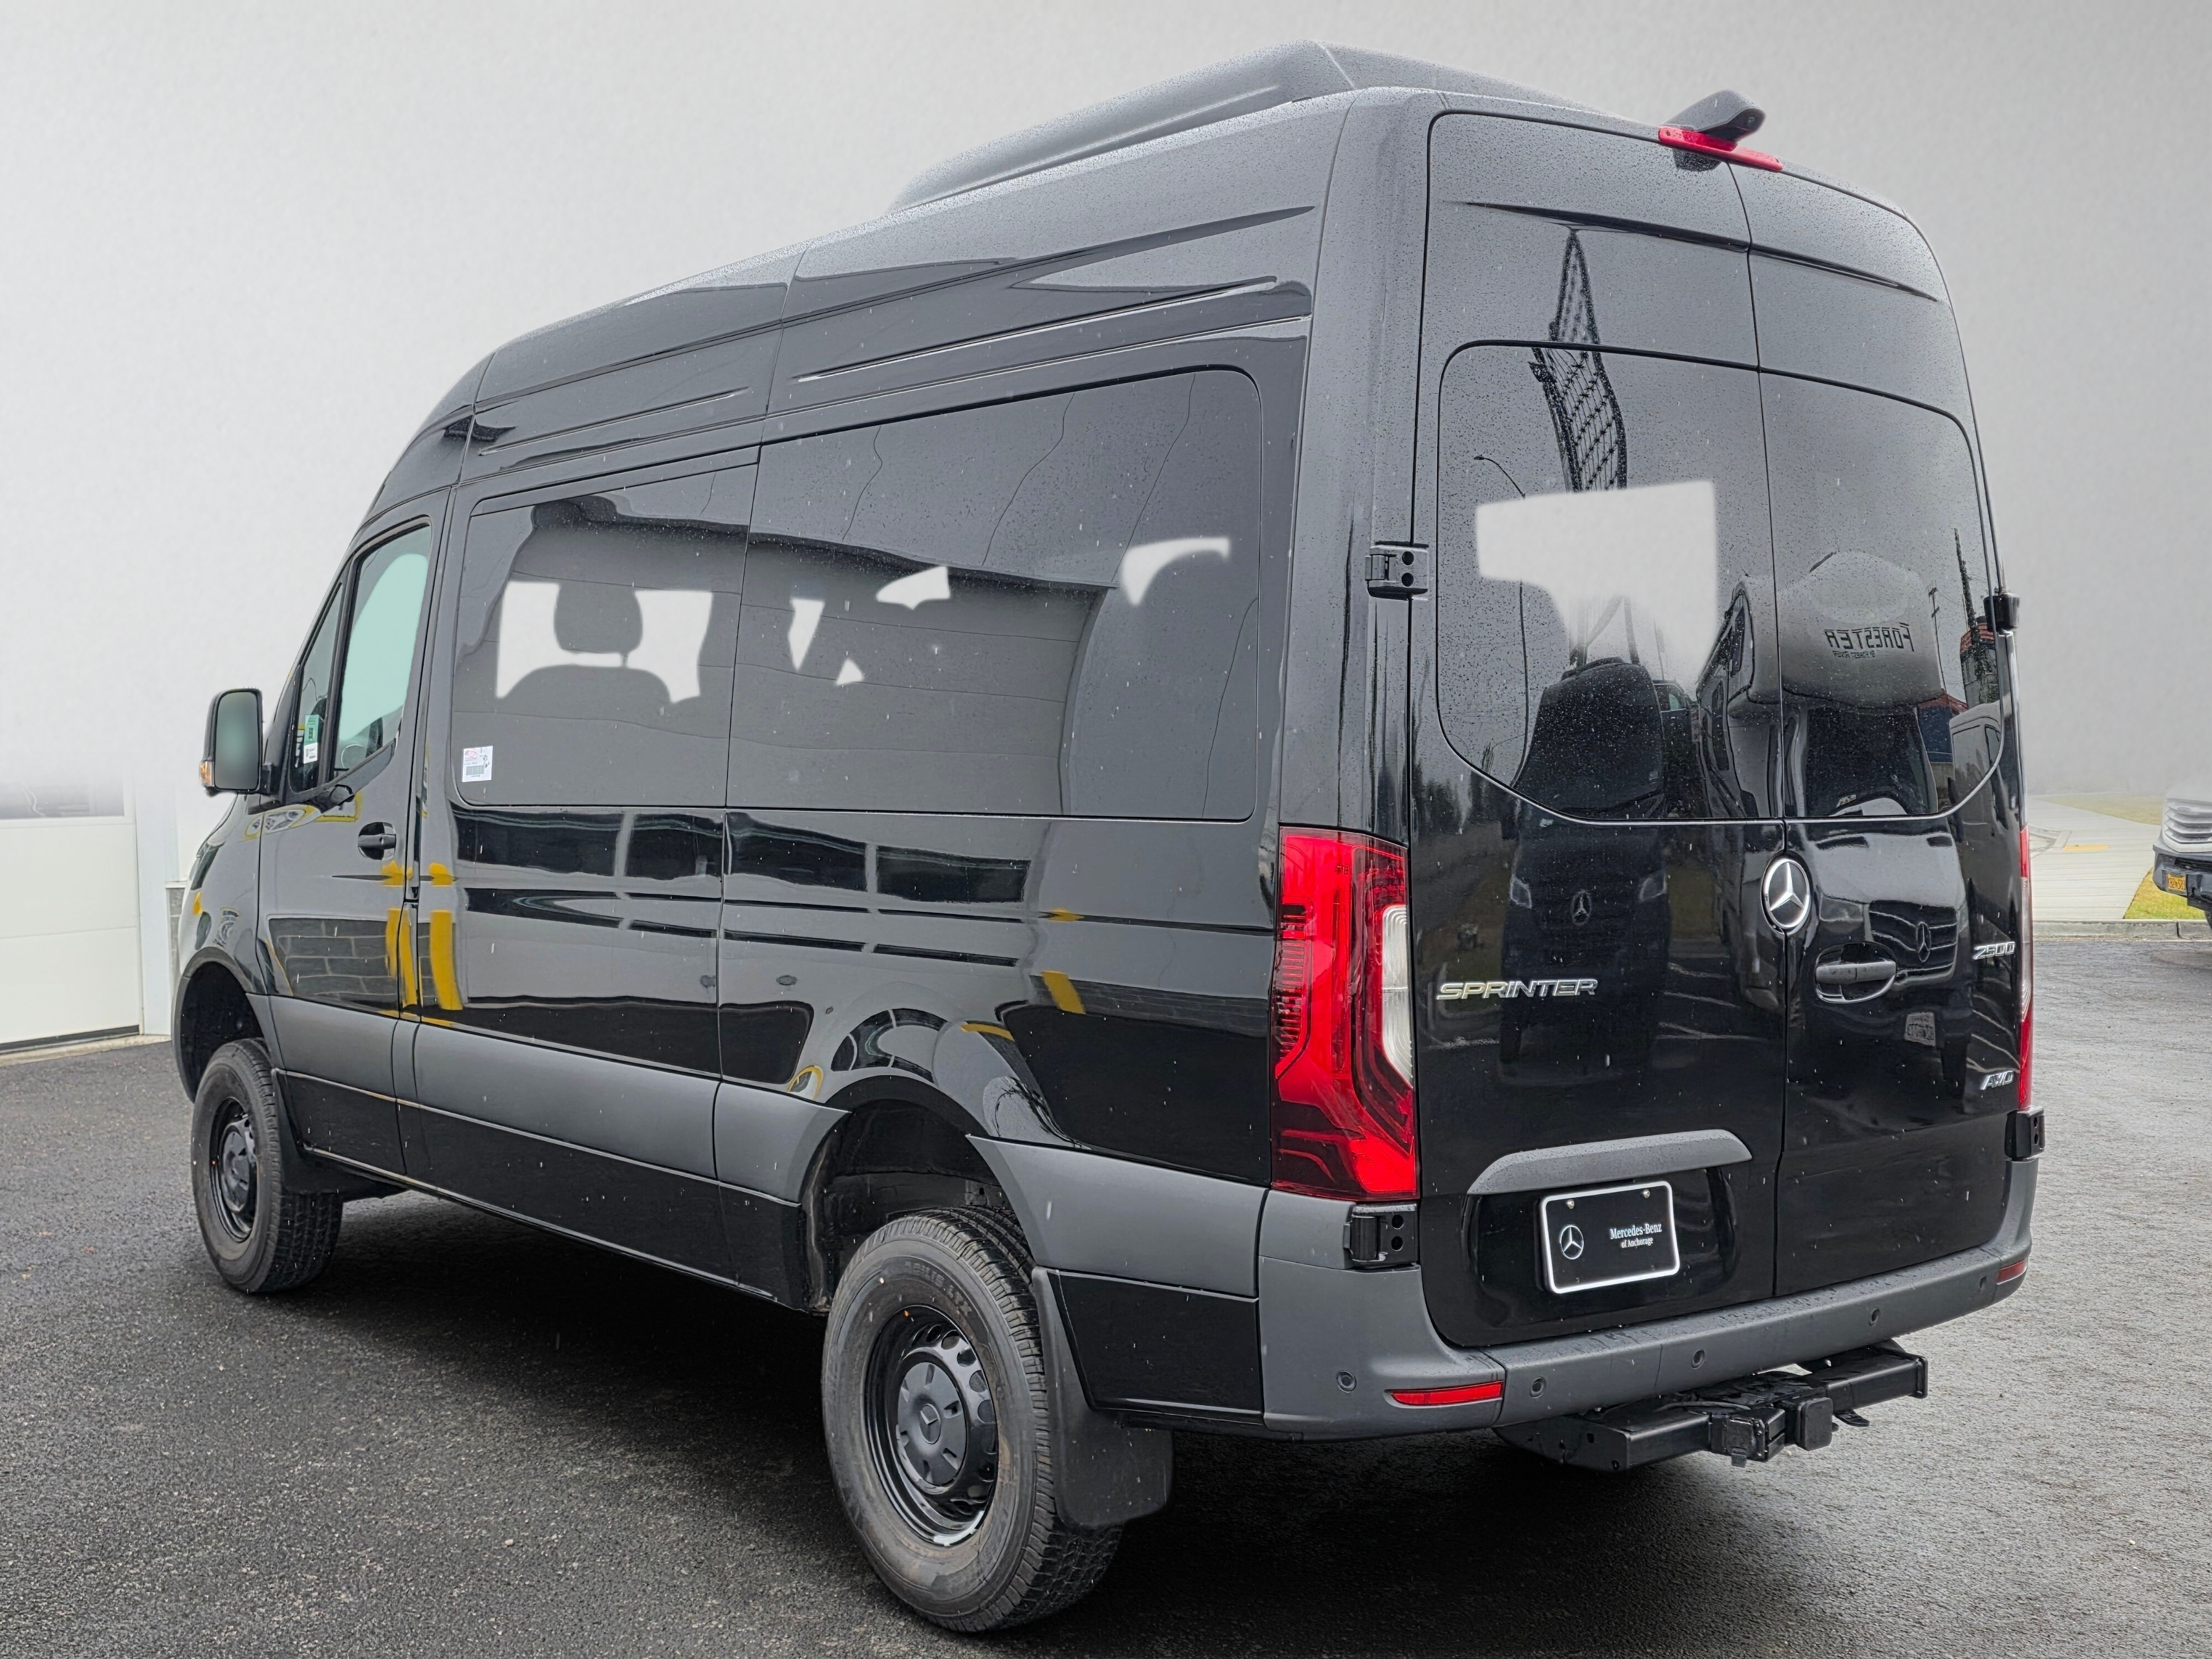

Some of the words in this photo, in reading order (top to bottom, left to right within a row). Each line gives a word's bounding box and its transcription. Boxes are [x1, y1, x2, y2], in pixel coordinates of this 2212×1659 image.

[1973, 941, 2016, 960] 2500
[1436, 978, 1598, 1000] SPRINTER
[1980, 1070, 2014, 1091] AWD
[1610, 1223, 1662, 1240] Mercedes-Benz
[1627, 1237, 1653, 1248] Anchorage
